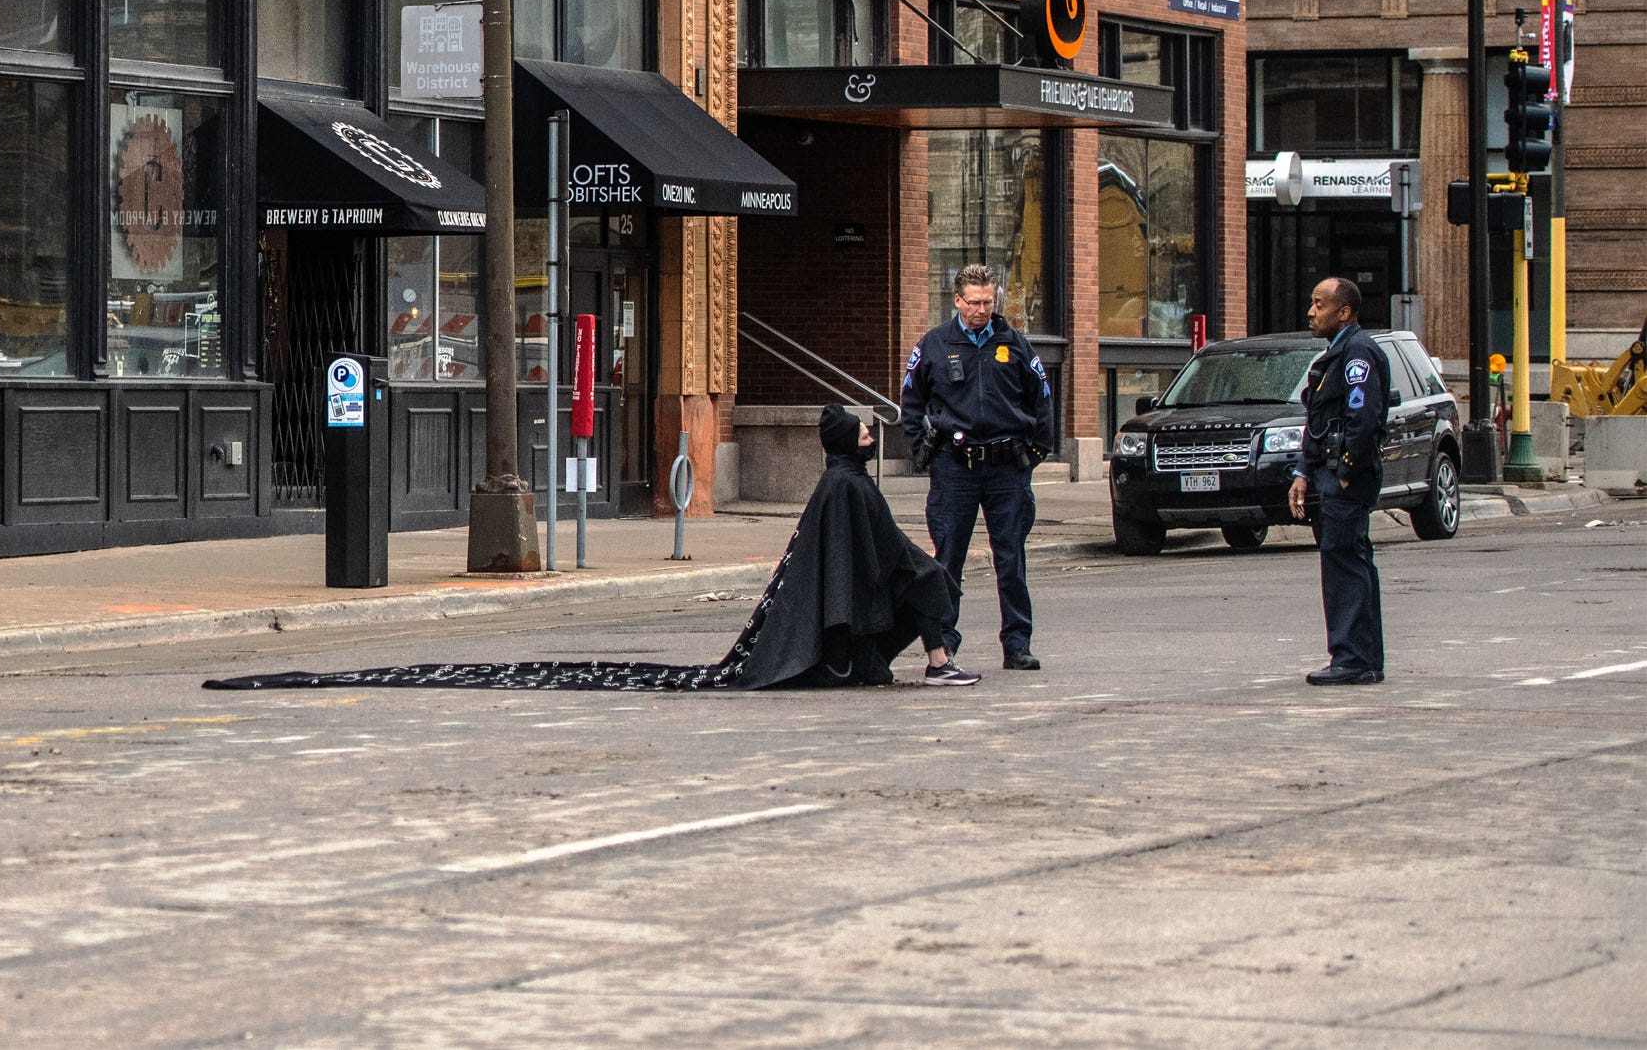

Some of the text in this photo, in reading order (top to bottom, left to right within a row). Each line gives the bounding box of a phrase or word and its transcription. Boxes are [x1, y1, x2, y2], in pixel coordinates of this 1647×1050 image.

[406, 61, 480, 75] Warehouse
[416, 76, 469, 90] District
[568, 163, 631, 186] OFTS
[1313, 175, 1391, 187] RENAISSANC
[662, 183, 697, 205] ONE20 INC.
[1351, 186, 1392, 194] LEARNIN
[741, 191, 792, 211] MINNEAPOLIS
[266, 207, 384, 225] BREWERY & TAPROOM
[834, 235, 865, 243] LOITERING
[1204, 422, 1253, 430] ROVER
[1184, 476, 1216, 487] VTH 962
